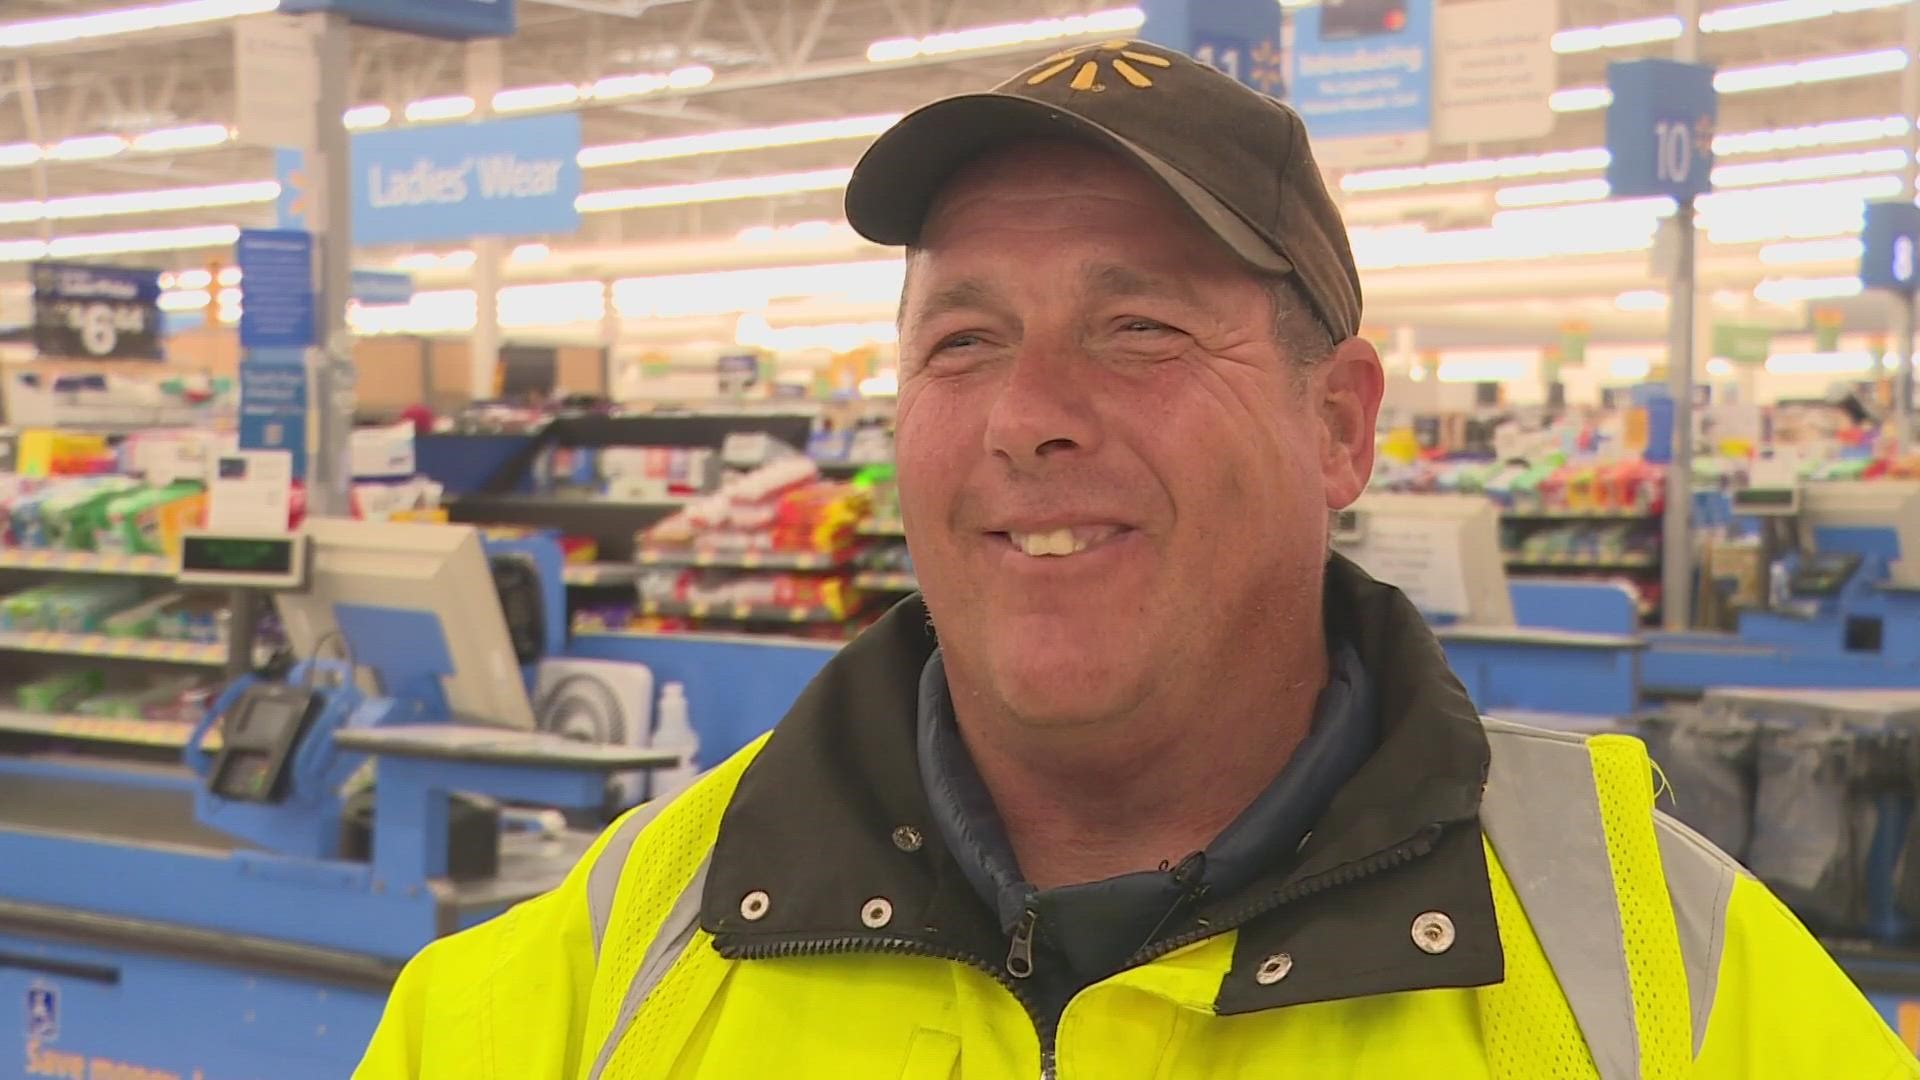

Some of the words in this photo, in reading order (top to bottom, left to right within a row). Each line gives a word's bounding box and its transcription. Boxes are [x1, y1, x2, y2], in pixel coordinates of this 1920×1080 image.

[1655, 121, 1691, 182] 10
[478, 153, 563, 198] Wear
[26, 1038, 86, 1080] Save
